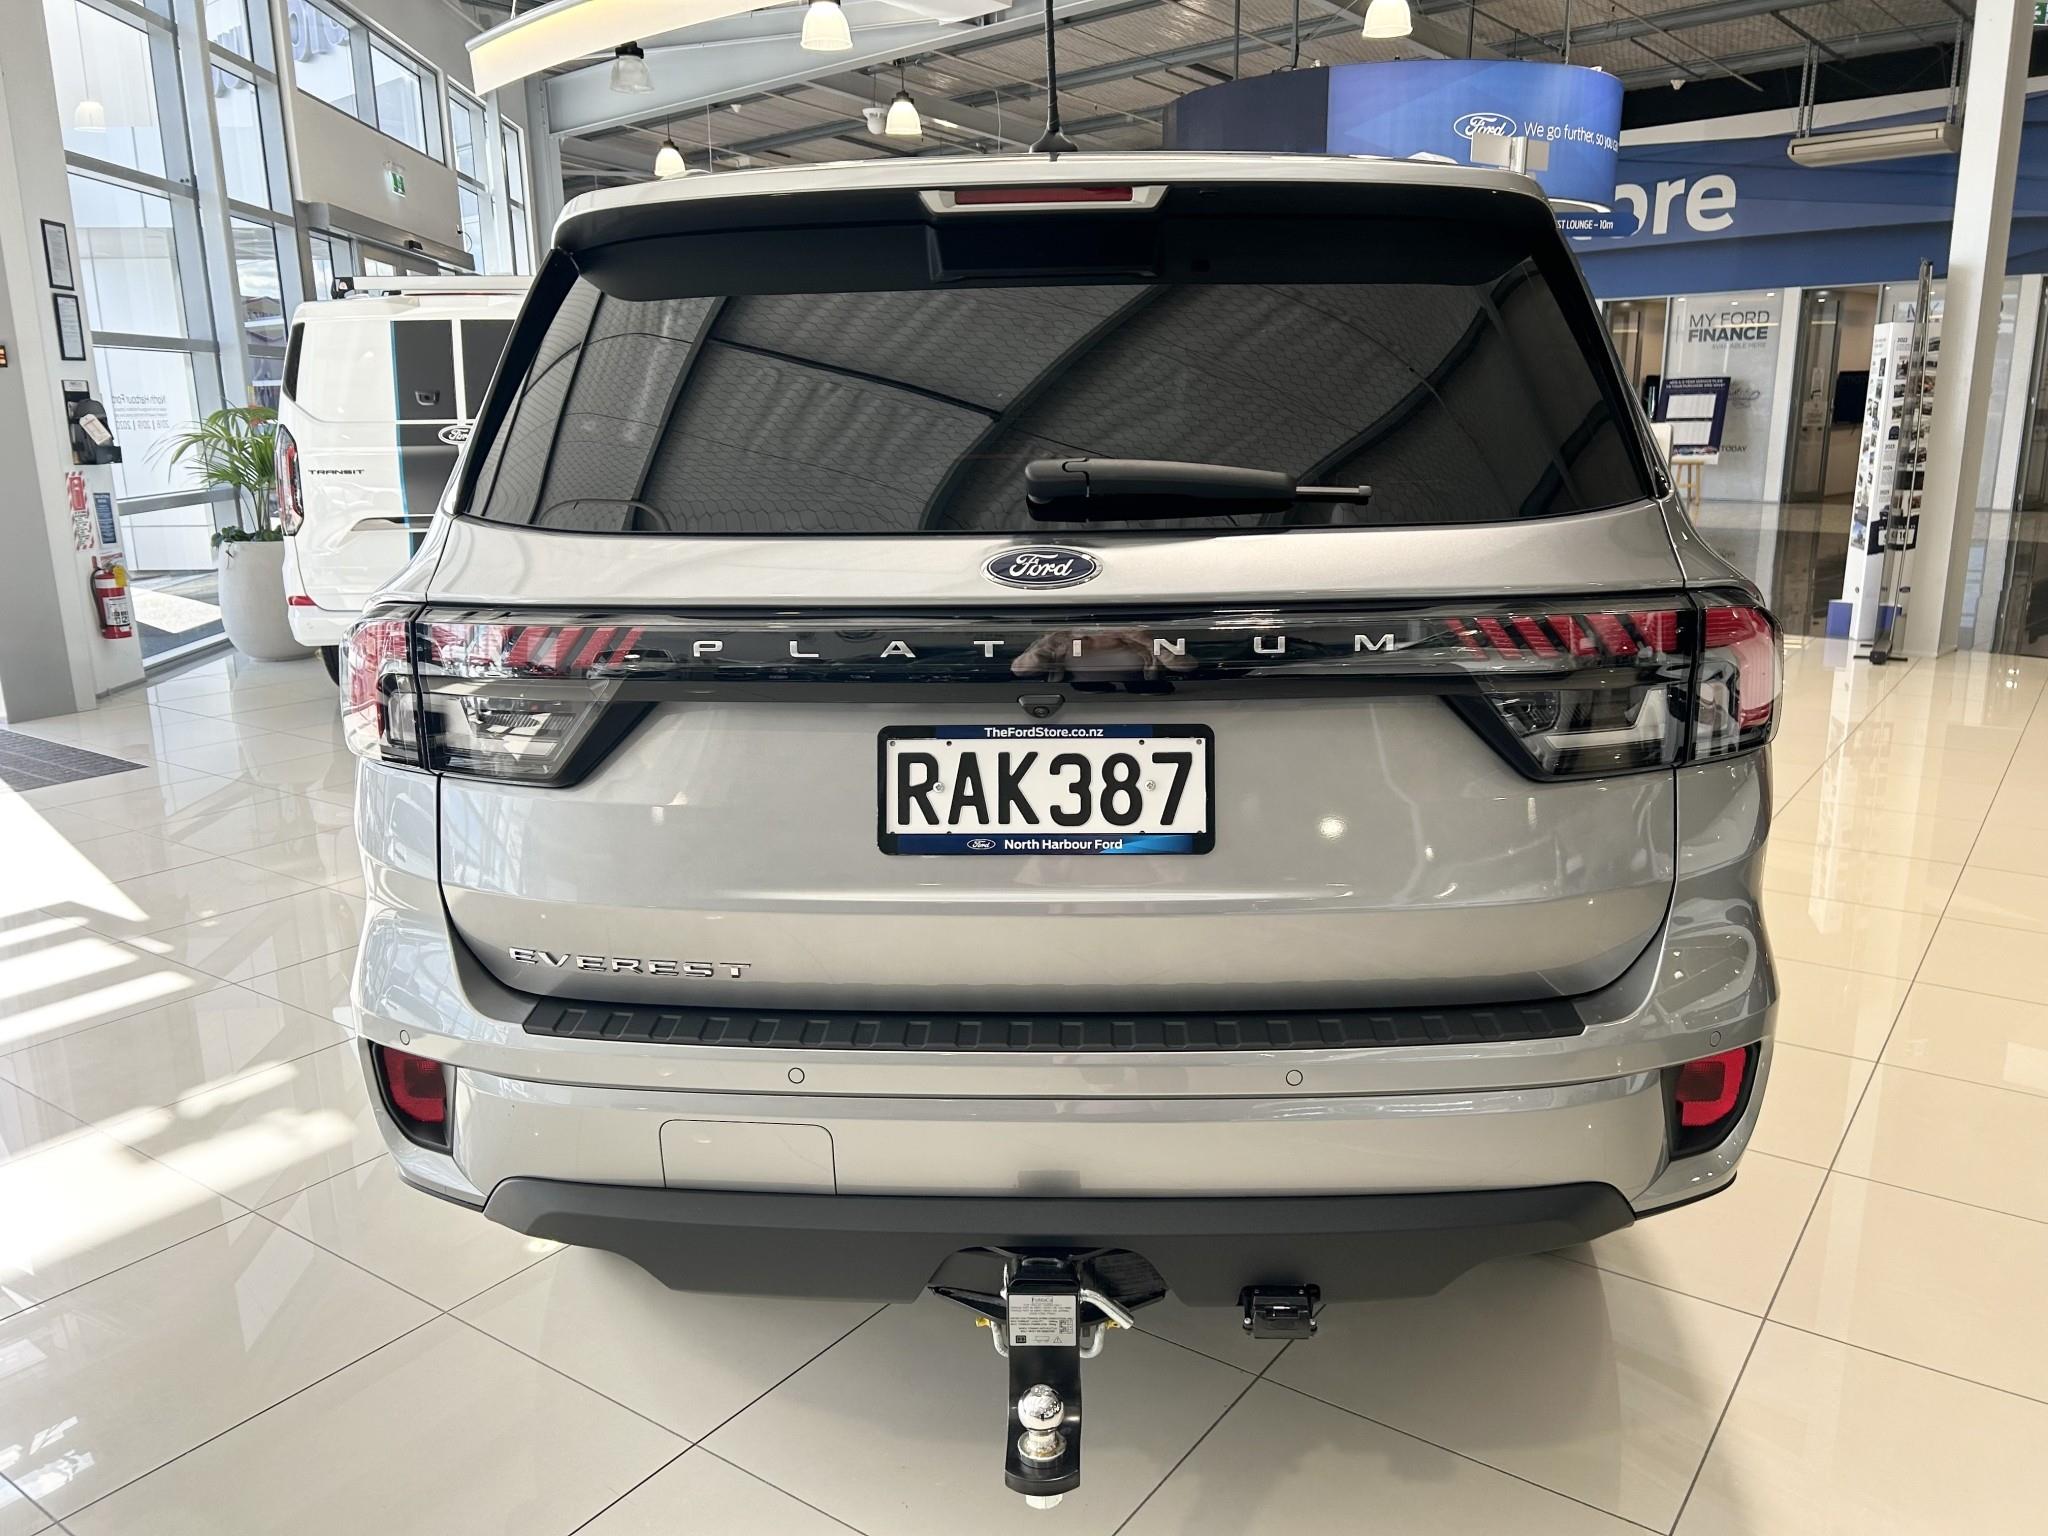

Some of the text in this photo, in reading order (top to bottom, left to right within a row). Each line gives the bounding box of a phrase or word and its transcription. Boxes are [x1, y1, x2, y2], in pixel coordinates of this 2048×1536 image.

[1465, 116, 1506, 136] Ford
[1524, 122, 1544, 137] We
[1547, 126, 1561, 140] go
[1564, 124, 1595, 144] further,
[1596, 133, 1604, 146] so
[1566, 219, 1593, 230] LOUNGE
[1600, 219, 1614, 230] 10m
[1690, 310, 1770, 328] MY FORD
[1688, 326, 1768, 343] FINANCE
[1009, 552, 1074, 577] Ford
[693, 634, 1395, 659] PLATINUM
[984, 726, 1104, 739] TheFordStore.co.nz
[897, 752, 1193, 826] RAK387
[1004, 839, 1040, 850] North
[1042, 839, 1092, 850] Harbour
[1094, 839, 1123, 850] Ford
[508, 946, 752, 979] EVEREST
